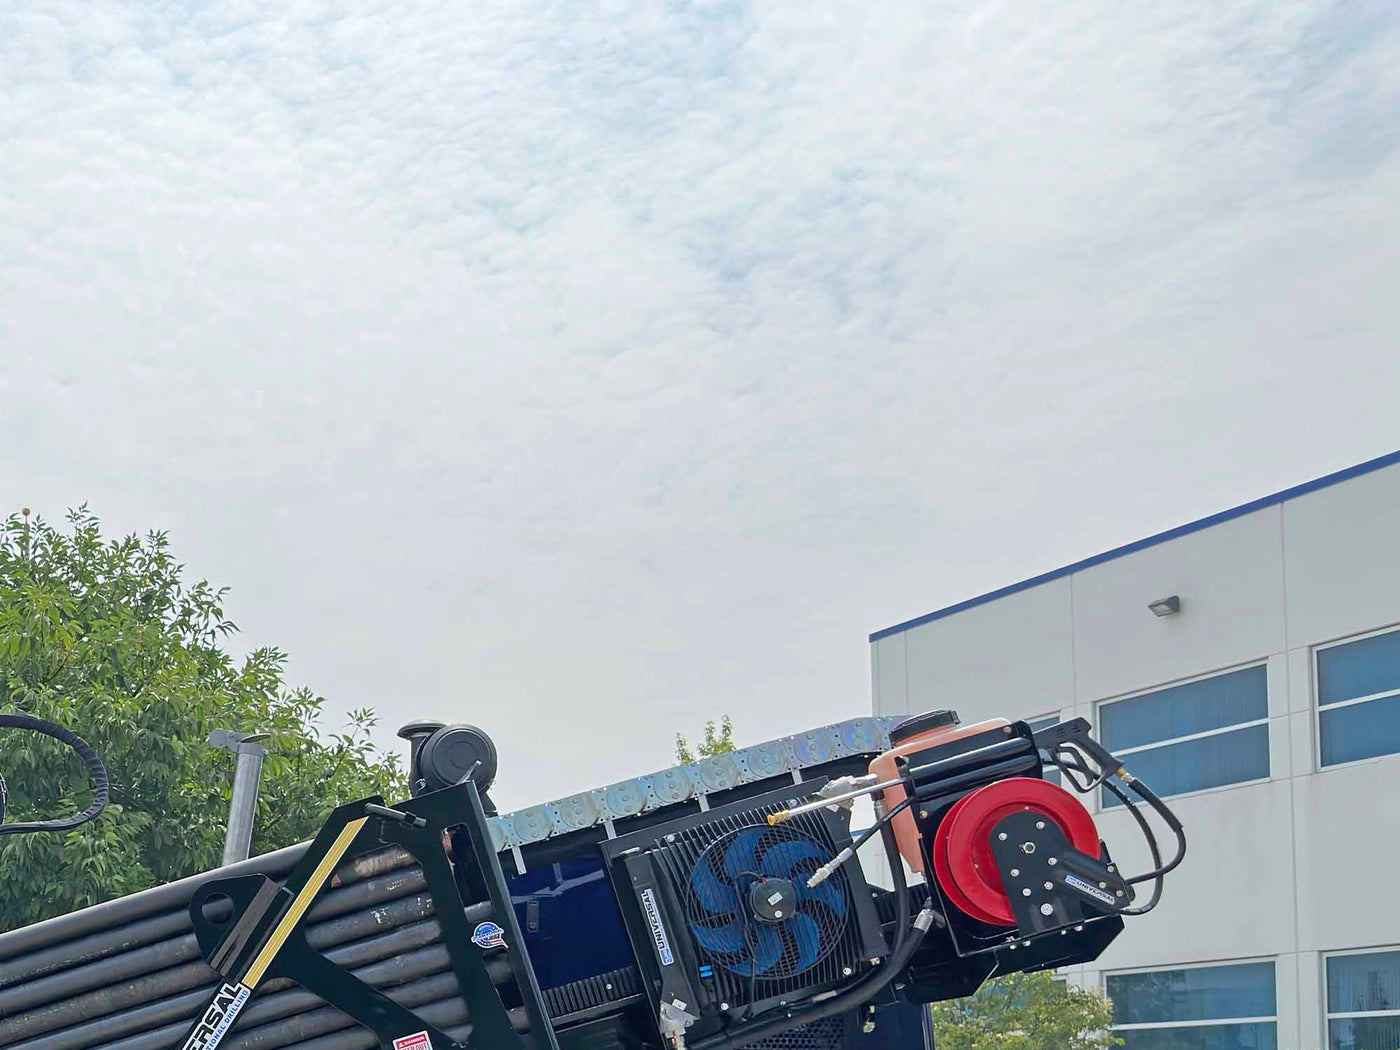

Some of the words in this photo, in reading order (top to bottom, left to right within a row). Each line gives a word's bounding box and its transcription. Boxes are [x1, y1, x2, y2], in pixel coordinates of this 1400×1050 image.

[642, 891, 665, 949] UNIVERSAL
[225, 989, 248, 1024] DRILLING
[416, 1043, 427, 1050] OUT
